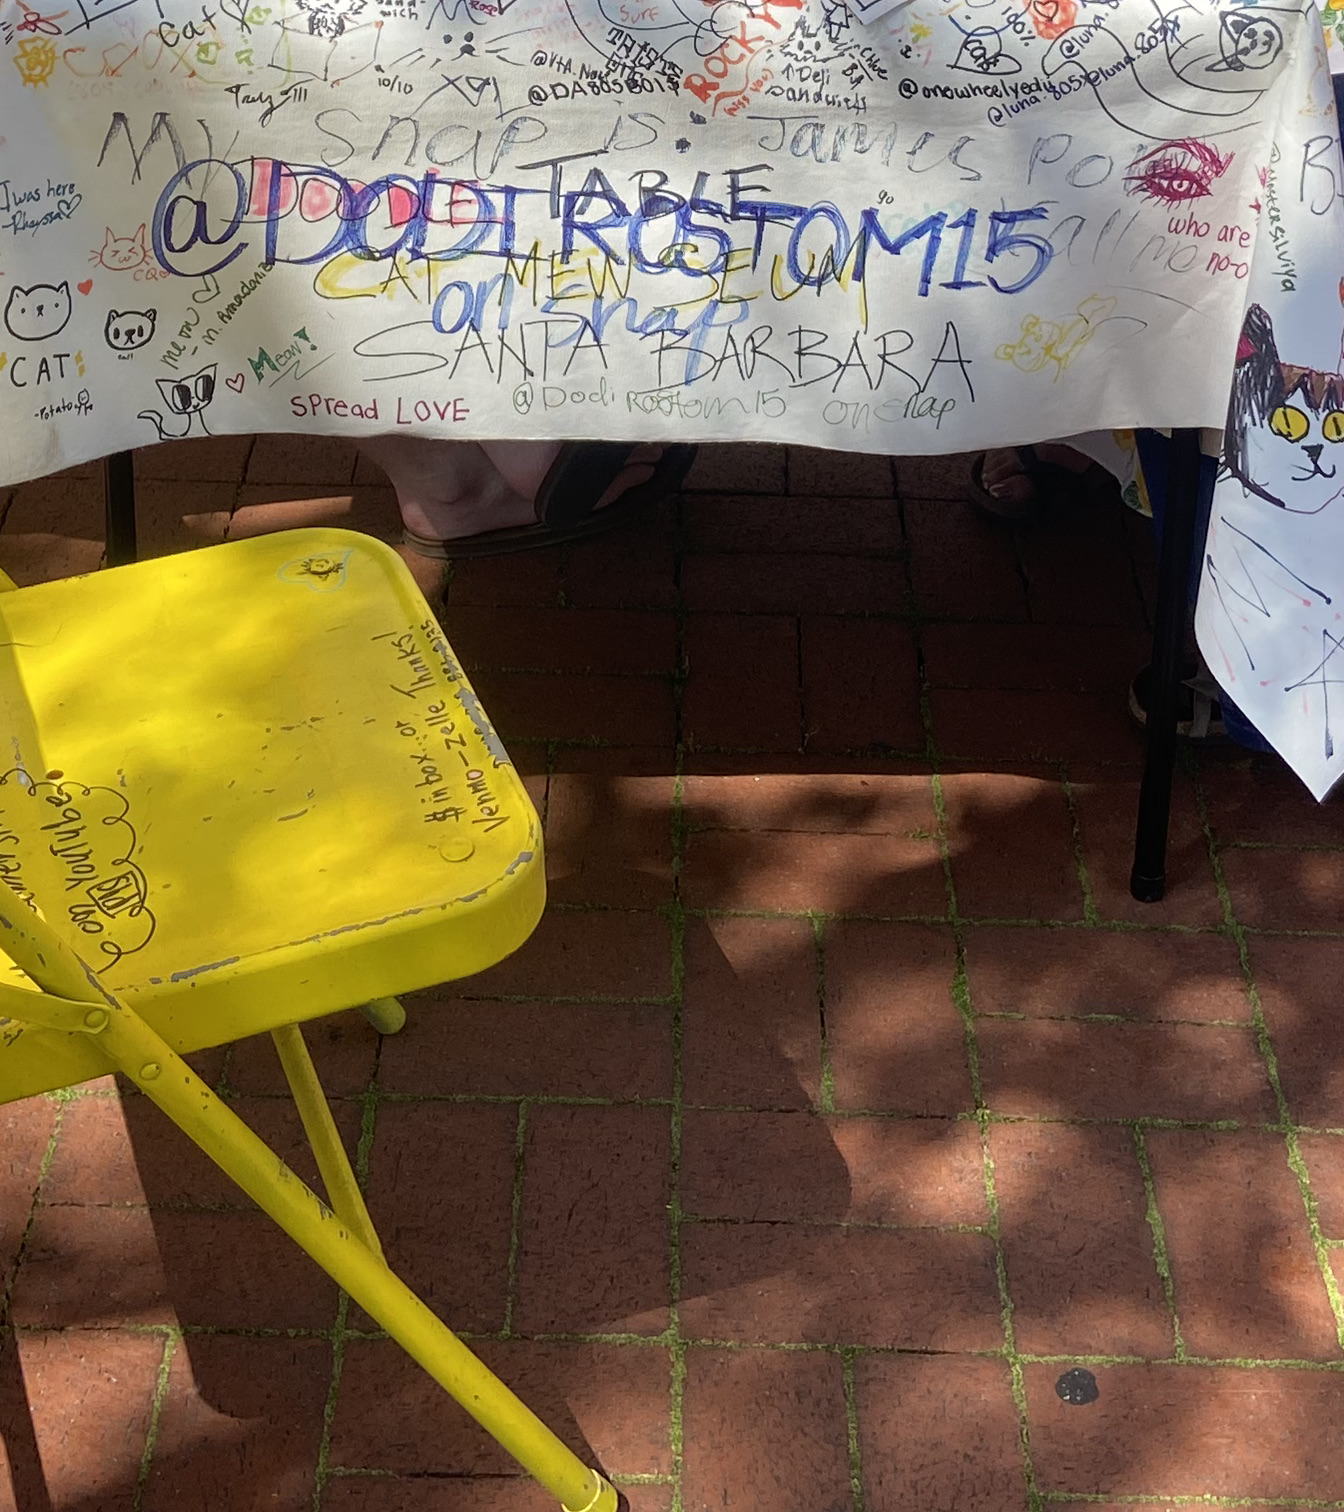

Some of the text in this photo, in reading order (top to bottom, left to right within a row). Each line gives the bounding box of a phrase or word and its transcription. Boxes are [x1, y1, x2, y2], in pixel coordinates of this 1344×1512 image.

[1167, 211, 1251, 249] who are
[9, 353, 71, 388] CAT
[352, 317, 976, 402] SANTA BARBARA
[396, 396, 470, 424] LOVE
